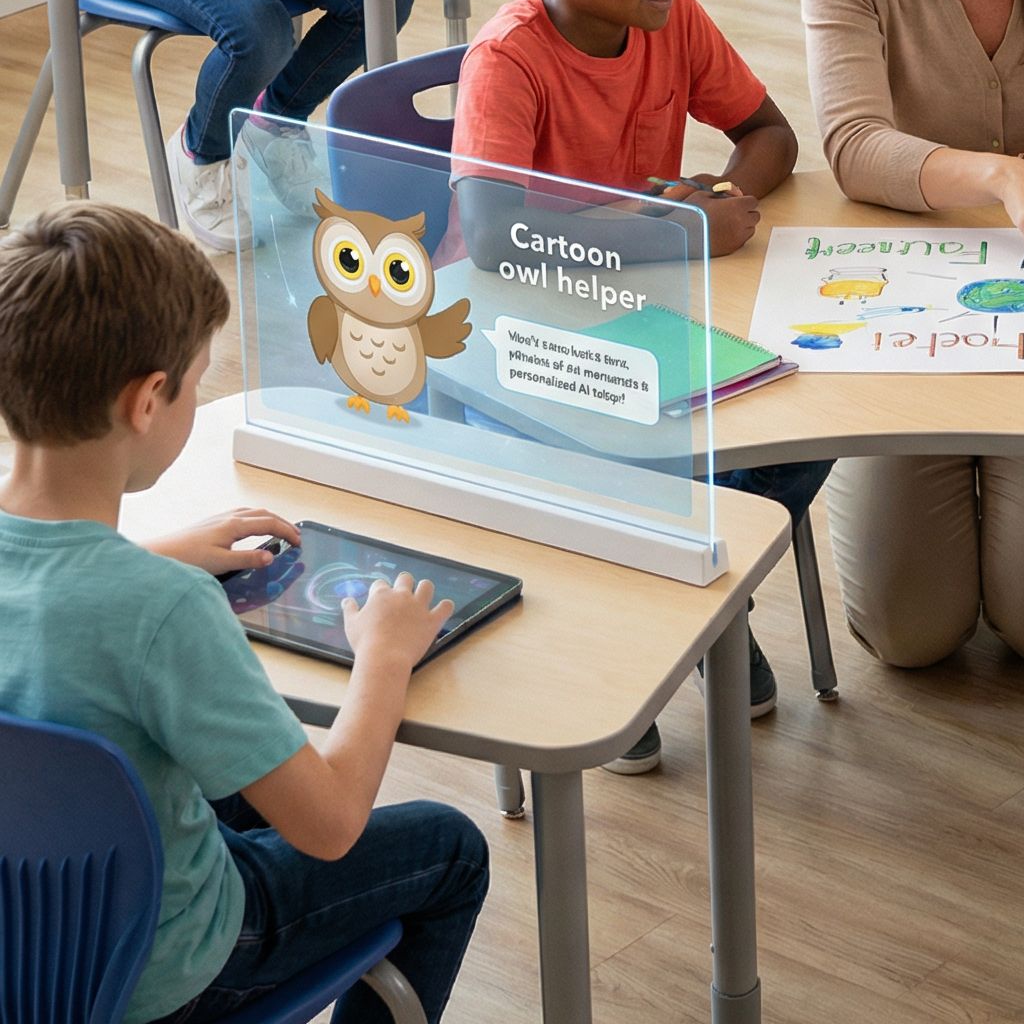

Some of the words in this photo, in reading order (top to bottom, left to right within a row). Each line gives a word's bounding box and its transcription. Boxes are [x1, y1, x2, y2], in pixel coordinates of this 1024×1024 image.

[510, 222, 622, 271] Cartoon
[498, 260, 548, 289] owl
[557, 264, 647, 312] helper
